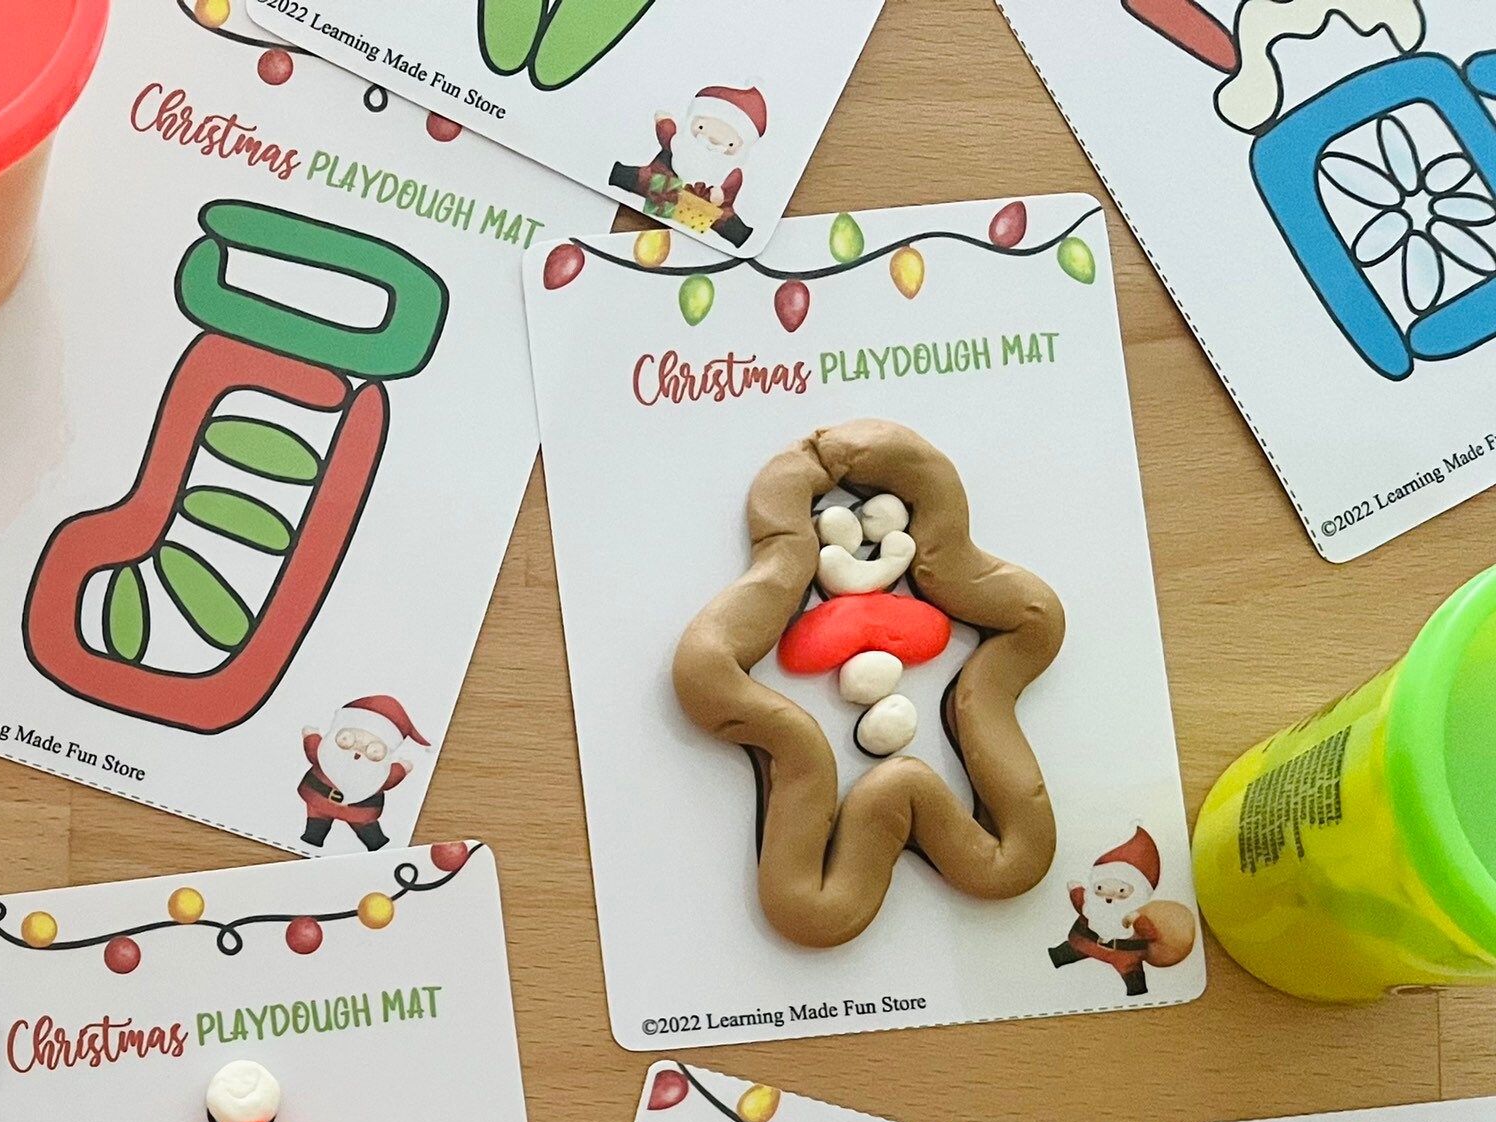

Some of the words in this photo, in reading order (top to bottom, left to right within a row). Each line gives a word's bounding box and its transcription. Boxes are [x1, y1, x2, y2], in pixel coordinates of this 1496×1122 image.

[257, 0, 306, 23] 2022
[310, 13, 380, 62] Learning
[383, 48, 428, 82] Made
[429, 71, 462, 99] Fun
[463, 88, 507, 120] Store
[130, 82, 302, 180] Christmas
[306, 149, 476, 231] PLAYDOUGH
[478, 204, 546, 250] MAT
[631, 349, 812, 407] Christmas
[819, 336, 992, 385] PLAYDOUGH
[1001, 332, 1061, 366] MAT
[1320, 500, 1375, 538] ©2022
[1373, 470, 1446, 511] Learning
[1441, 444, 1486, 474] Made
[14, 725, 63, 755] Made
[65, 742, 99, 767] Fun
[101, 754, 147, 782] Store
[6, 1015, 190, 1074] Christmas
[196, 992, 372, 1046] PLAYDOUGH
[380, 985, 443, 1020] MAT
[641, 1014, 703, 1036] ©2022
[706, 1008, 785, 1028] Learning
[789, 1002, 839, 1023] Made
[842, 999, 877, 1016] Fun
[880, 995, 928, 1013] Store
